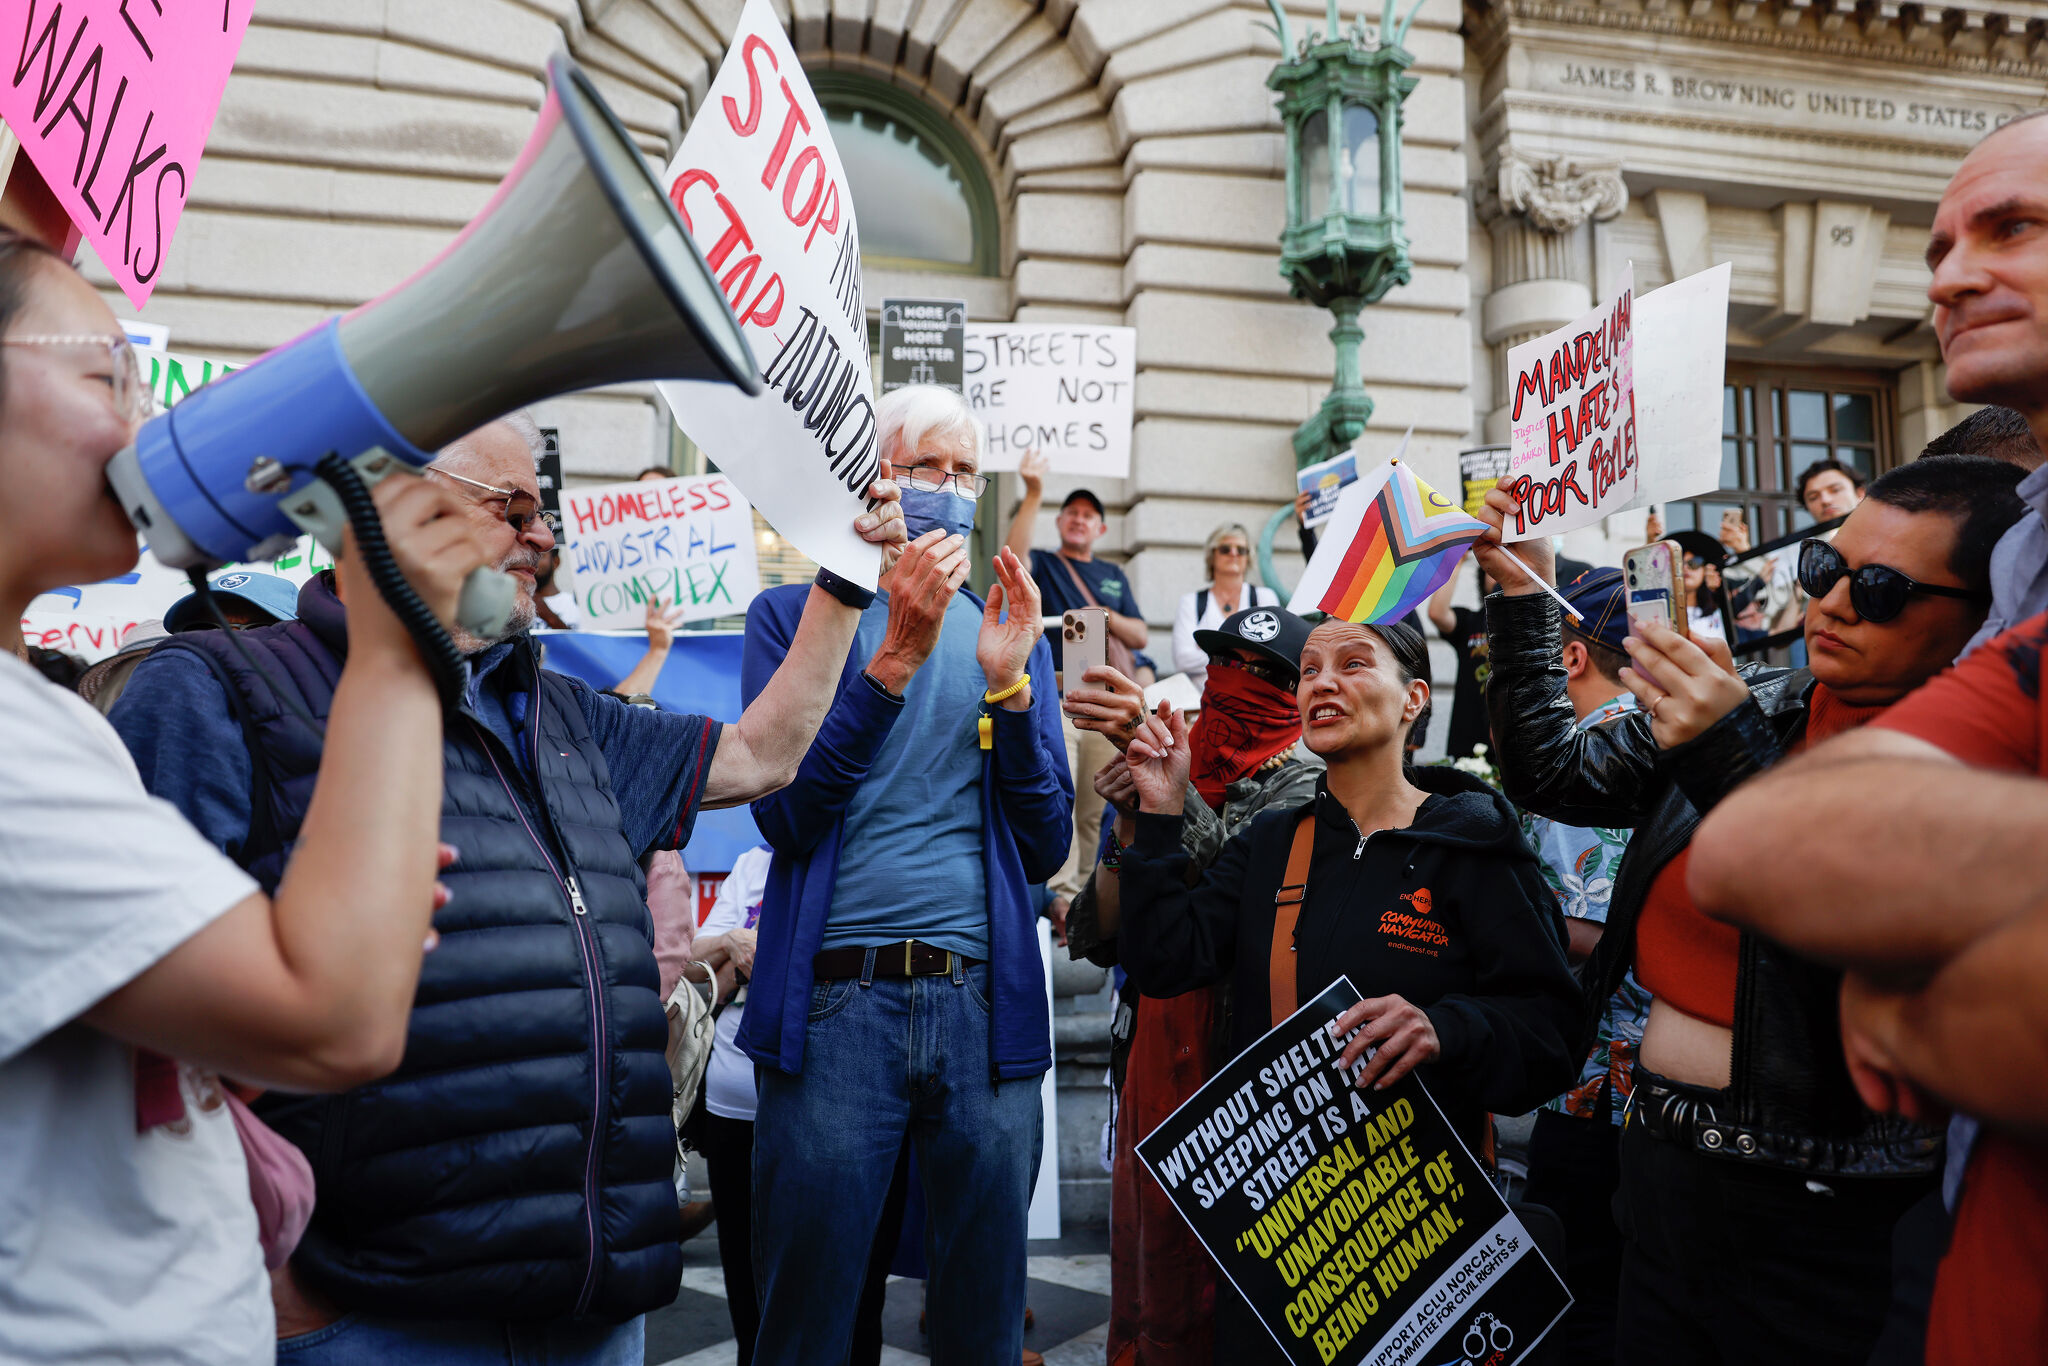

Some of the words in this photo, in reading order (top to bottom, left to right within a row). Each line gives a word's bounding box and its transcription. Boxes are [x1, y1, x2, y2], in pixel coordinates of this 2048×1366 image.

[1560, 62, 1636, 92] JAMES
[1644, 74, 1663, 96] R.
[1671, 76, 1797, 110] BROWNING
[1807, 91, 1896, 121] UNITED
[1906, 103, 1987, 131] STATES
[13, 0, 186, 284] WALKS
[722, 33, 840, 254] STOP
[1830, 224, 1855, 248] 95
[903, 306, 945, 320] MORE
[903, 331, 945, 345] MORE
[964, 332, 1117, 374] STREETS
[969, 379, 1008, 409] RE
[1057, 377, 1129, 404] NOT
[1546, 366, 1620, 467] HATES
[987, 421, 1108, 453] HOMES
[569, 480, 732, 535] HOMELESS
[1511, 461, 1589, 535] POOR
[569, 519, 737, 575] INDUSTRIAL
[586, 558, 734, 618] COMPLEX
[1377, 922, 1449, 947] NAVIGATOR
[1158, 1080, 1260, 1190] WITHOUT
[1192, 1101, 1293, 1210] SLEEPING
[1293, 1070, 1333, 1117] ON
[1242, 1123, 1318, 1212] STREET
[1318, 1105, 1348, 1142] IS
[1349, 1090, 1371, 1124] A
[1364, 1097, 1415, 1156] AND
[1275, 1135, 1421, 1288] UNAVOIDABLE
[1284, 1176, 1430, 1339] CONSEQUENCE
[1424, 1150, 1456, 1195] OF
[1312, 1280, 1380, 1366] BEING
[1370, 1321, 1416, 1366] PPORT
[1416, 1288, 1447, 1326] ACLU
[1446, 1243, 1497, 1294] NORCAL
[1496, 1233, 1508, 1246] &
[1388, 1318, 1440, 1366] OMMITTEE
[1438, 1301, 1458, 1325] FOR
[1453, 1278, 1479, 1307] CIVIL
[1476, 1248, 1511, 1286] RIGHTS
[1506, 1236, 1520, 1255] SF
